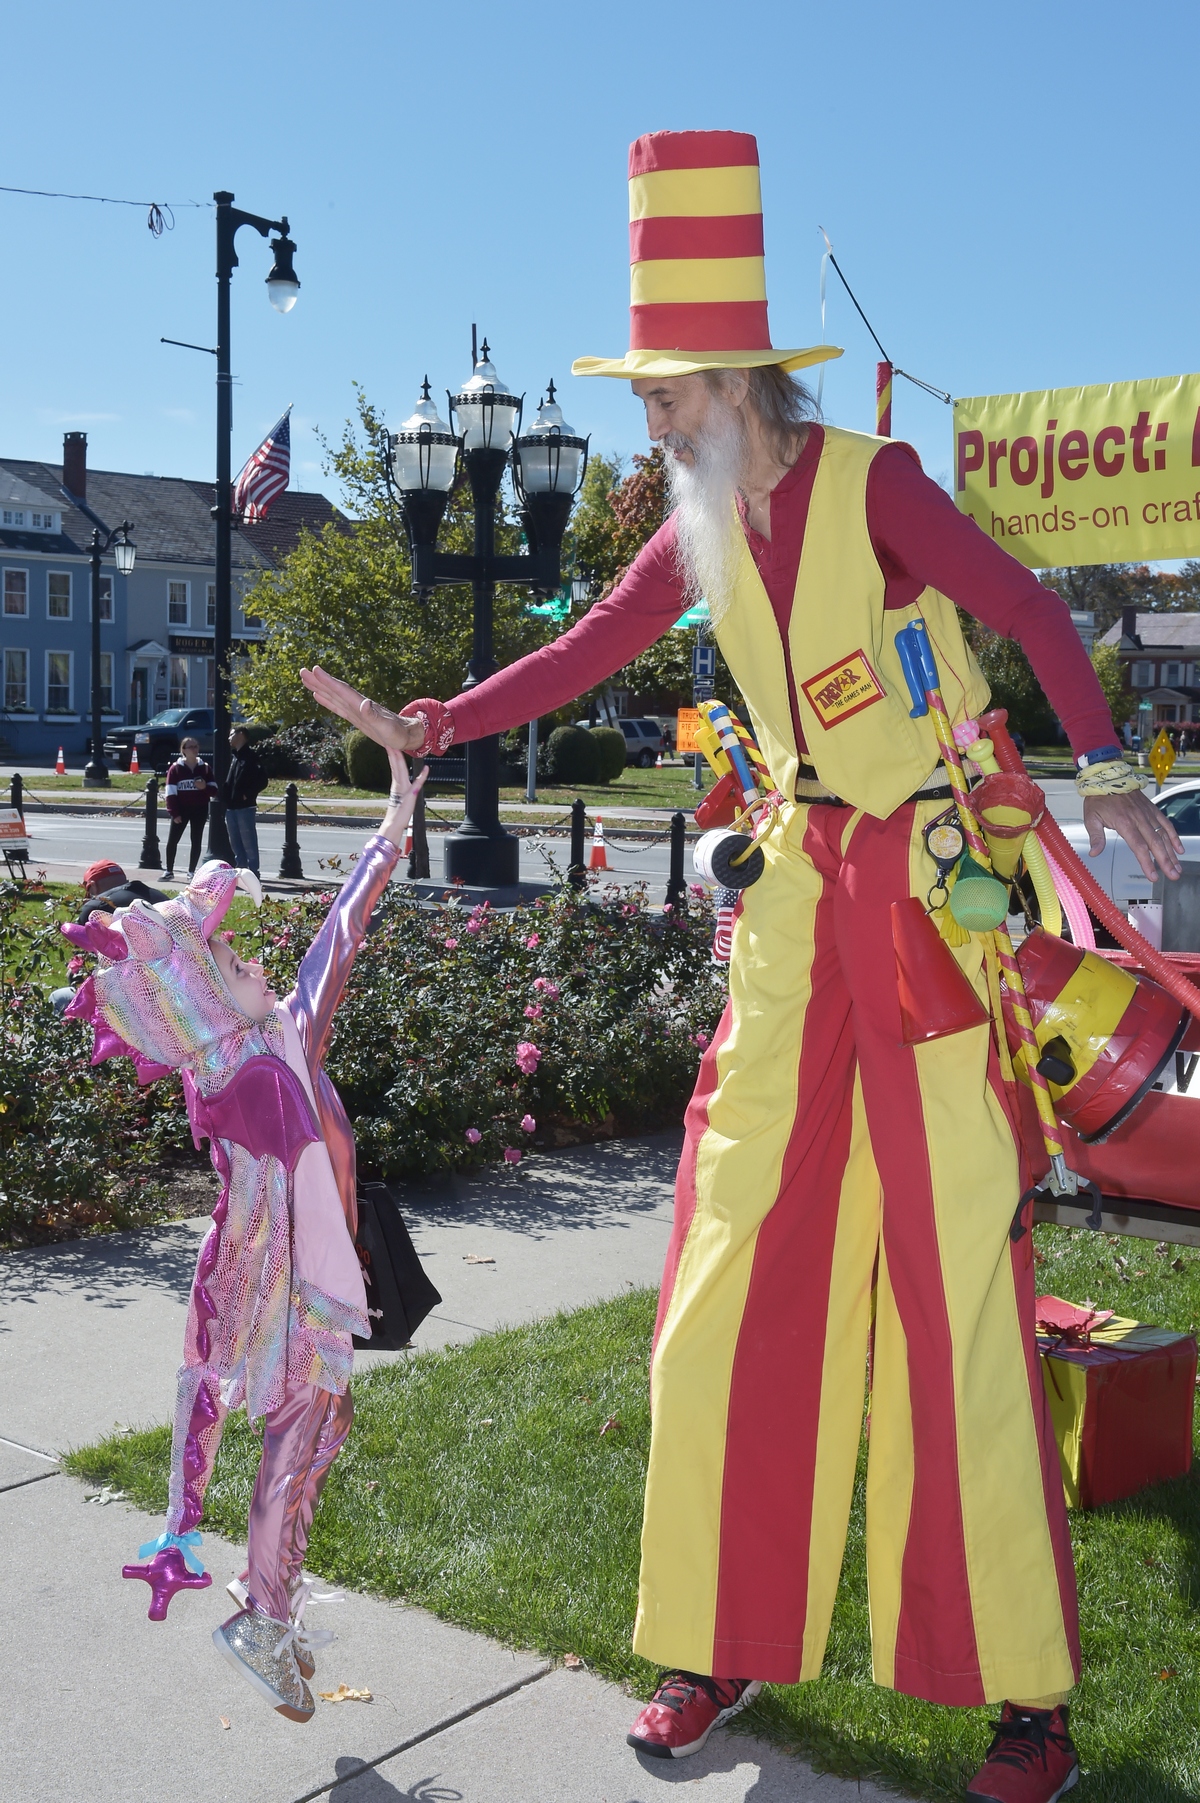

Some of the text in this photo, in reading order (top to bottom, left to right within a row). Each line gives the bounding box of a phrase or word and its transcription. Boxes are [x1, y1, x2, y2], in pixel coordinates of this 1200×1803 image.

[957, 411, 1170, 499] Project:
[991, 504, 1129, 538] hands-on
[175, 638, 208, 648] ROGER
[695, 648, 712, 674] H
[813, 668, 861, 710] TREVOR
[843, 689, 861, 704] GAMES
